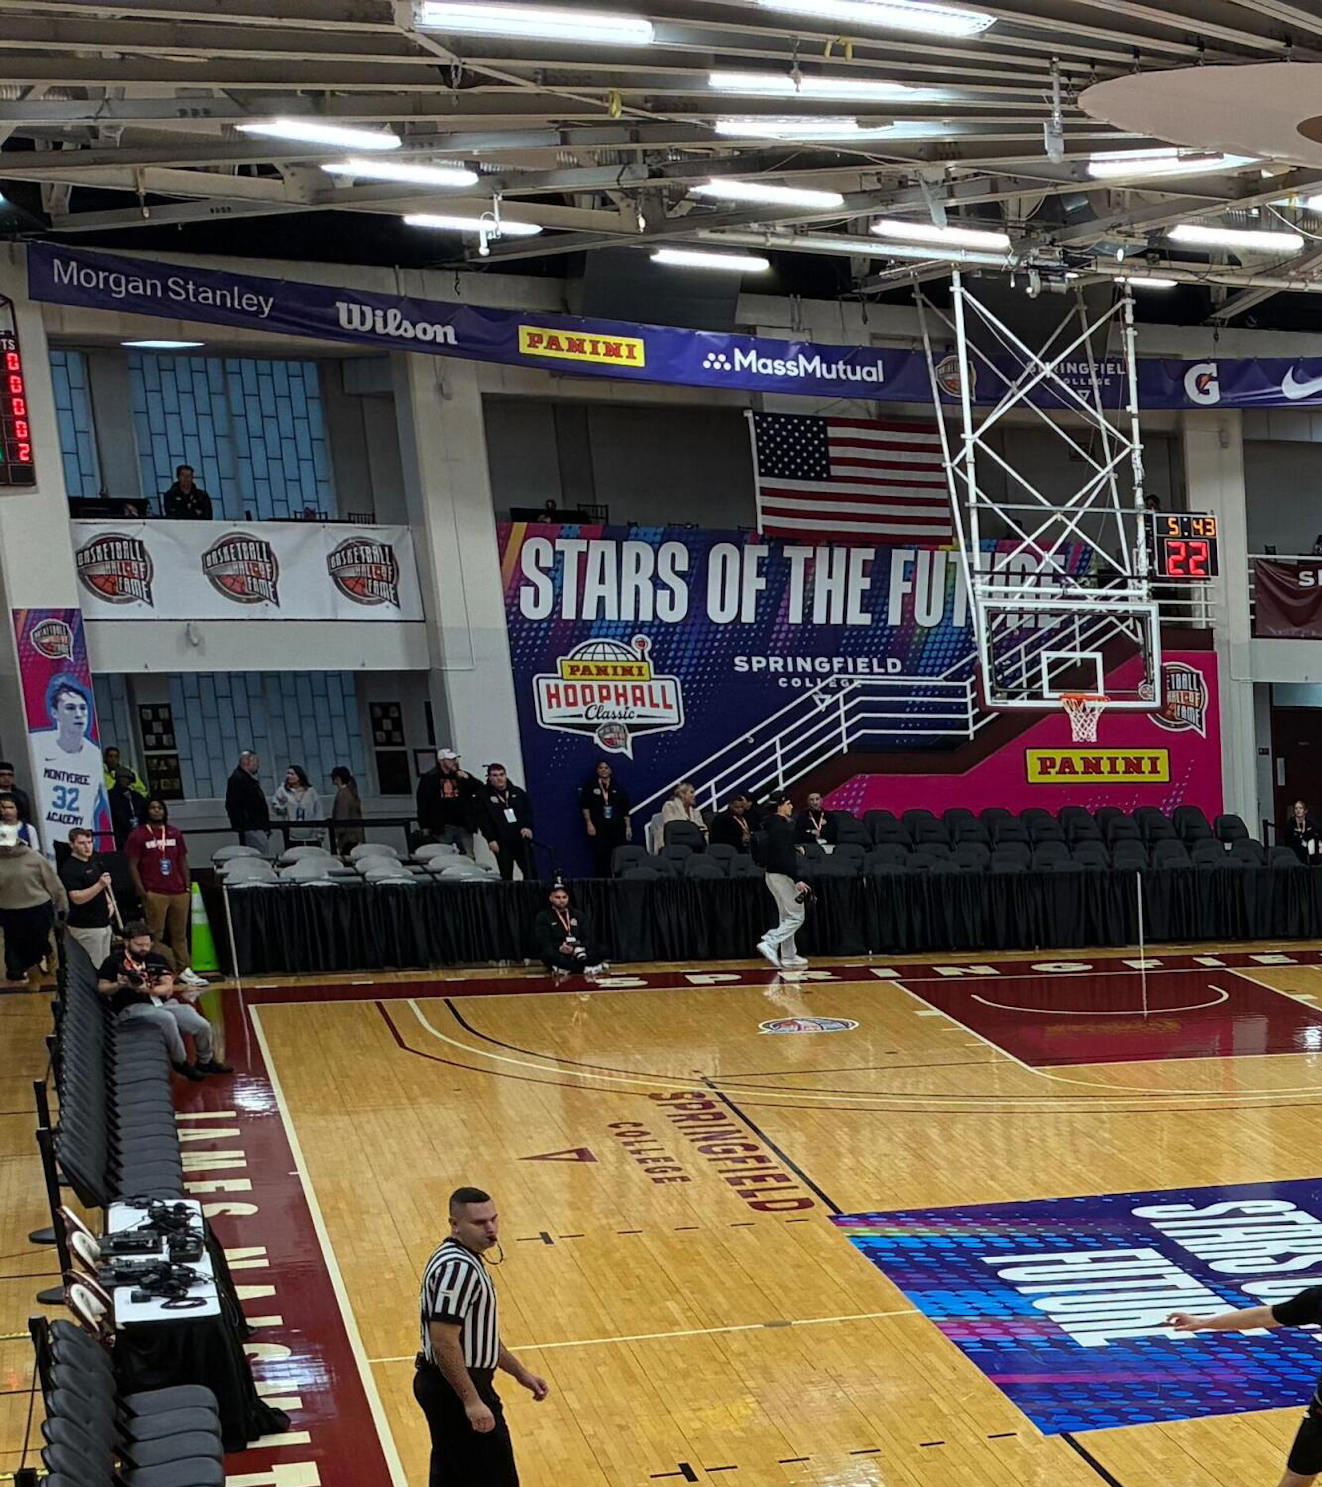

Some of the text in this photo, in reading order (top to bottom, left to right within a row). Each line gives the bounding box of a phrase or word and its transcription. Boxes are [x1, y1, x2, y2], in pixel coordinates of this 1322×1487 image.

[52, 258, 275, 318] Morgan Stanley
[336, 300, 458, 346] Wilson
[526, 332, 637, 360] PANINI
[734, 347, 885, 383] MassMutual
[1027, 361, 1127, 375] SRINGFIEL
[1060, 377, 1111, 386] OLLEGE
[1184, 362, 1221, 405] G
[1167, 540, 1208, 576] 22
[519, 536, 689, 623] STARS
[707, 541, 770, 623] OF
[782, 544, 875, 626] THE
[567, 664, 646, 677] PANINI
[734, 656, 902, 674] SPRINGFIELD
[778, 677, 863, 688] COLLEGE
[545, 683, 674, 710] HOOPHALL
[584, 704, 636, 721] Classic
[1037, 755, 1161, 776] PANINI
[52, 785, 80, 812] 32
[607, 1121, 692, 1184] COLLEGE
[647, 1091, 816, 1212] SPRINGFIELD
